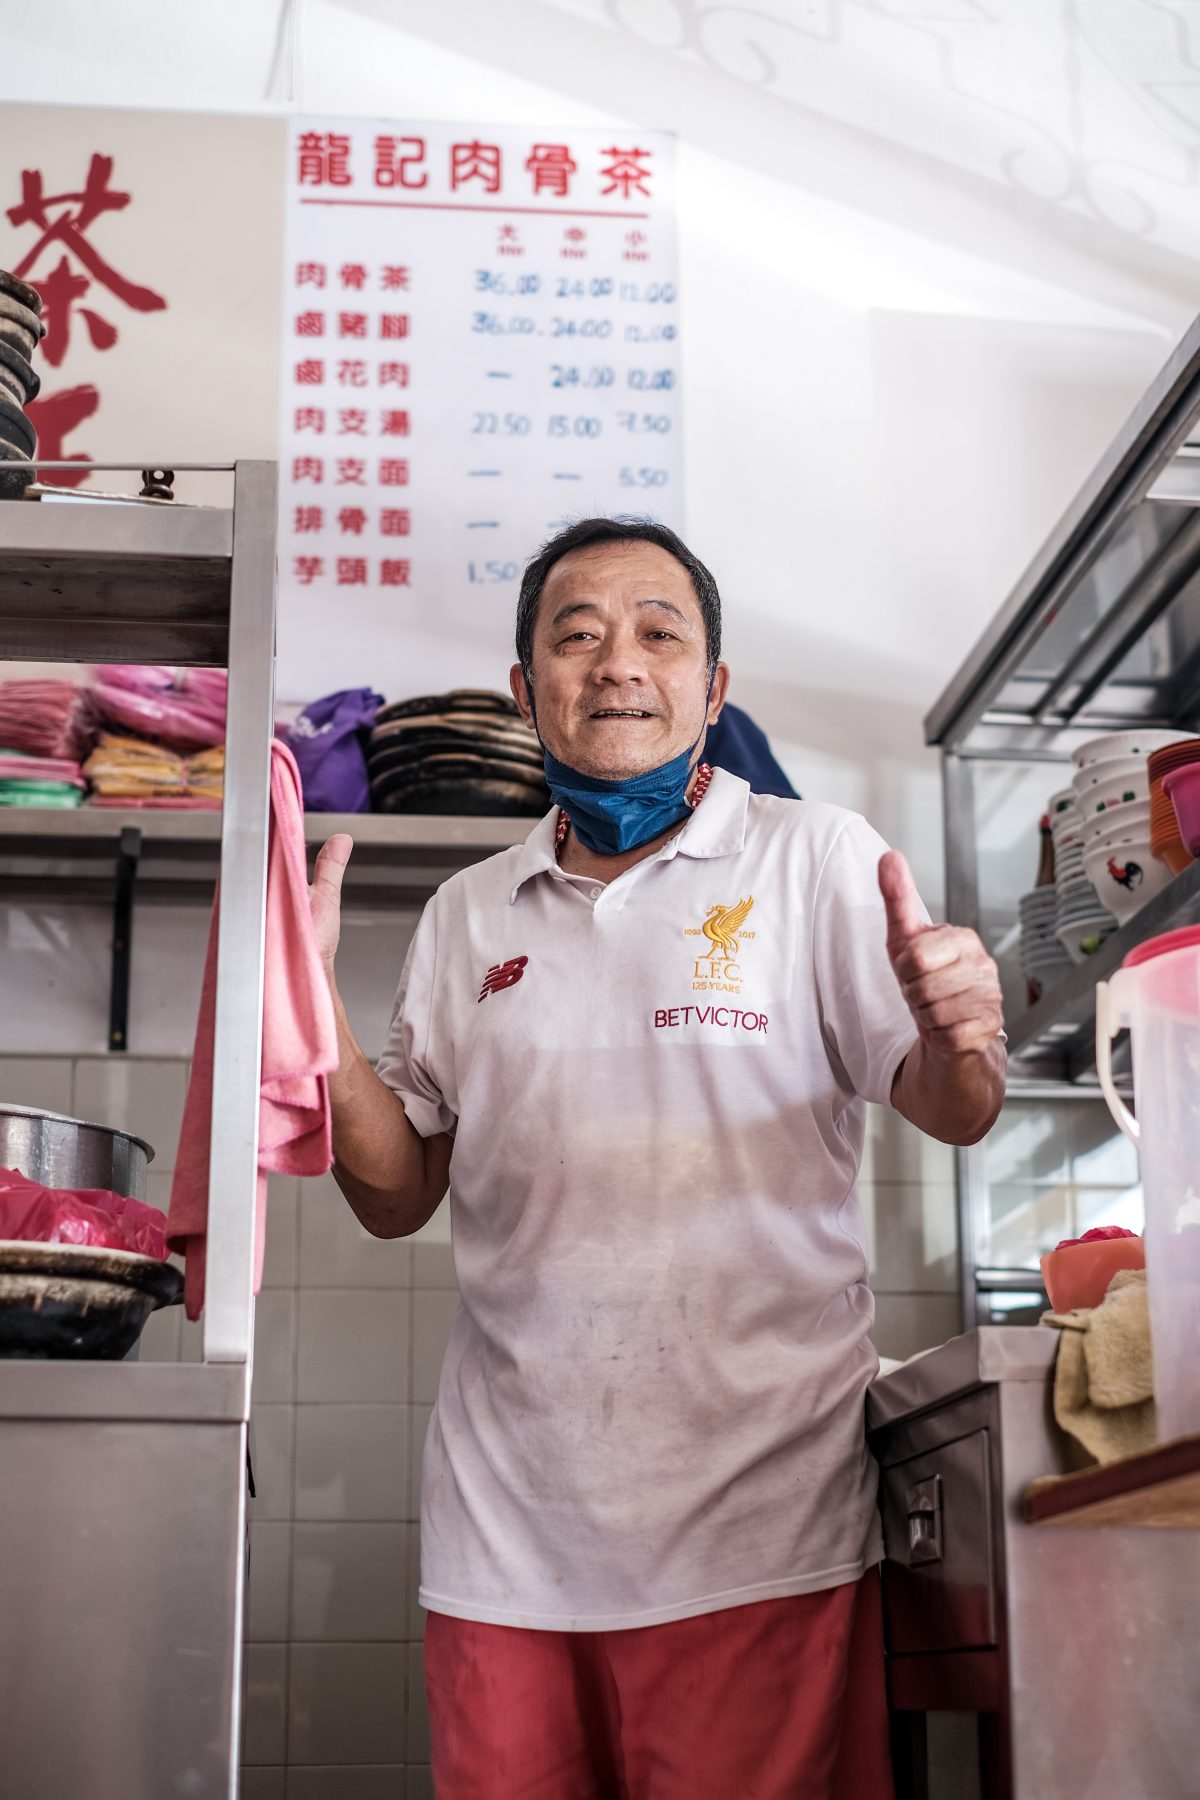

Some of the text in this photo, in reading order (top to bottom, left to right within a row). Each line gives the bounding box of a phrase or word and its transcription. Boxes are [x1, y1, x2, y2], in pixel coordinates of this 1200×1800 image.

[297, 131, 654, 199] 龍記肉骨茶
[295, 261, 411, 291] 肉骨茶
[692, 981, 742, 994] 125 YEARS
[655, 1006, 769, 1034] BETVICTOR
